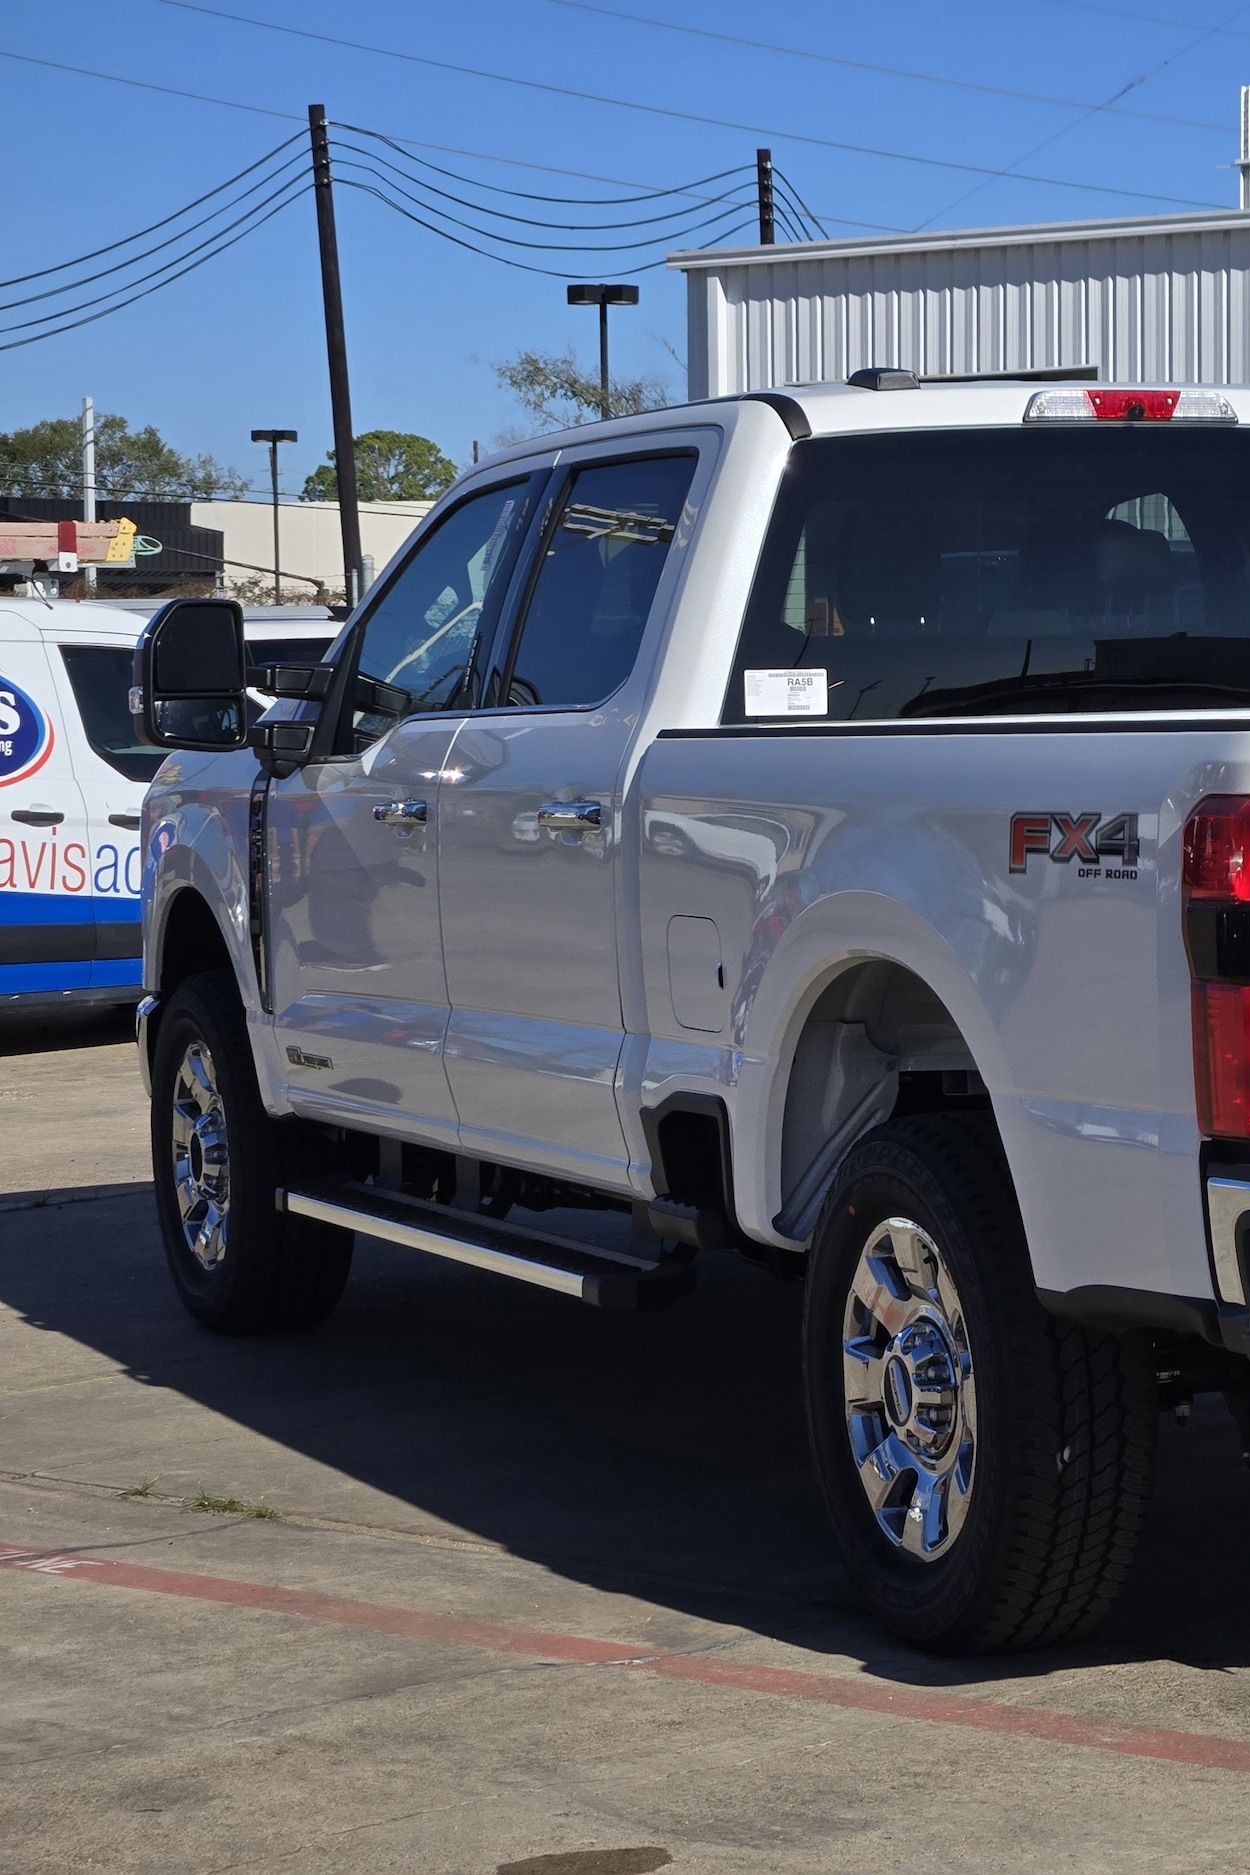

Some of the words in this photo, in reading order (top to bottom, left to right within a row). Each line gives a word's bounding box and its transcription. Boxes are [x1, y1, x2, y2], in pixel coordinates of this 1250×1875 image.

[787, 677, 814, 687] RA5B
[1009, 811, 1140, 874] FX4
[1078, 868, 1101, 879] OFF
[1105, 869, 1138, 880] ROAD
